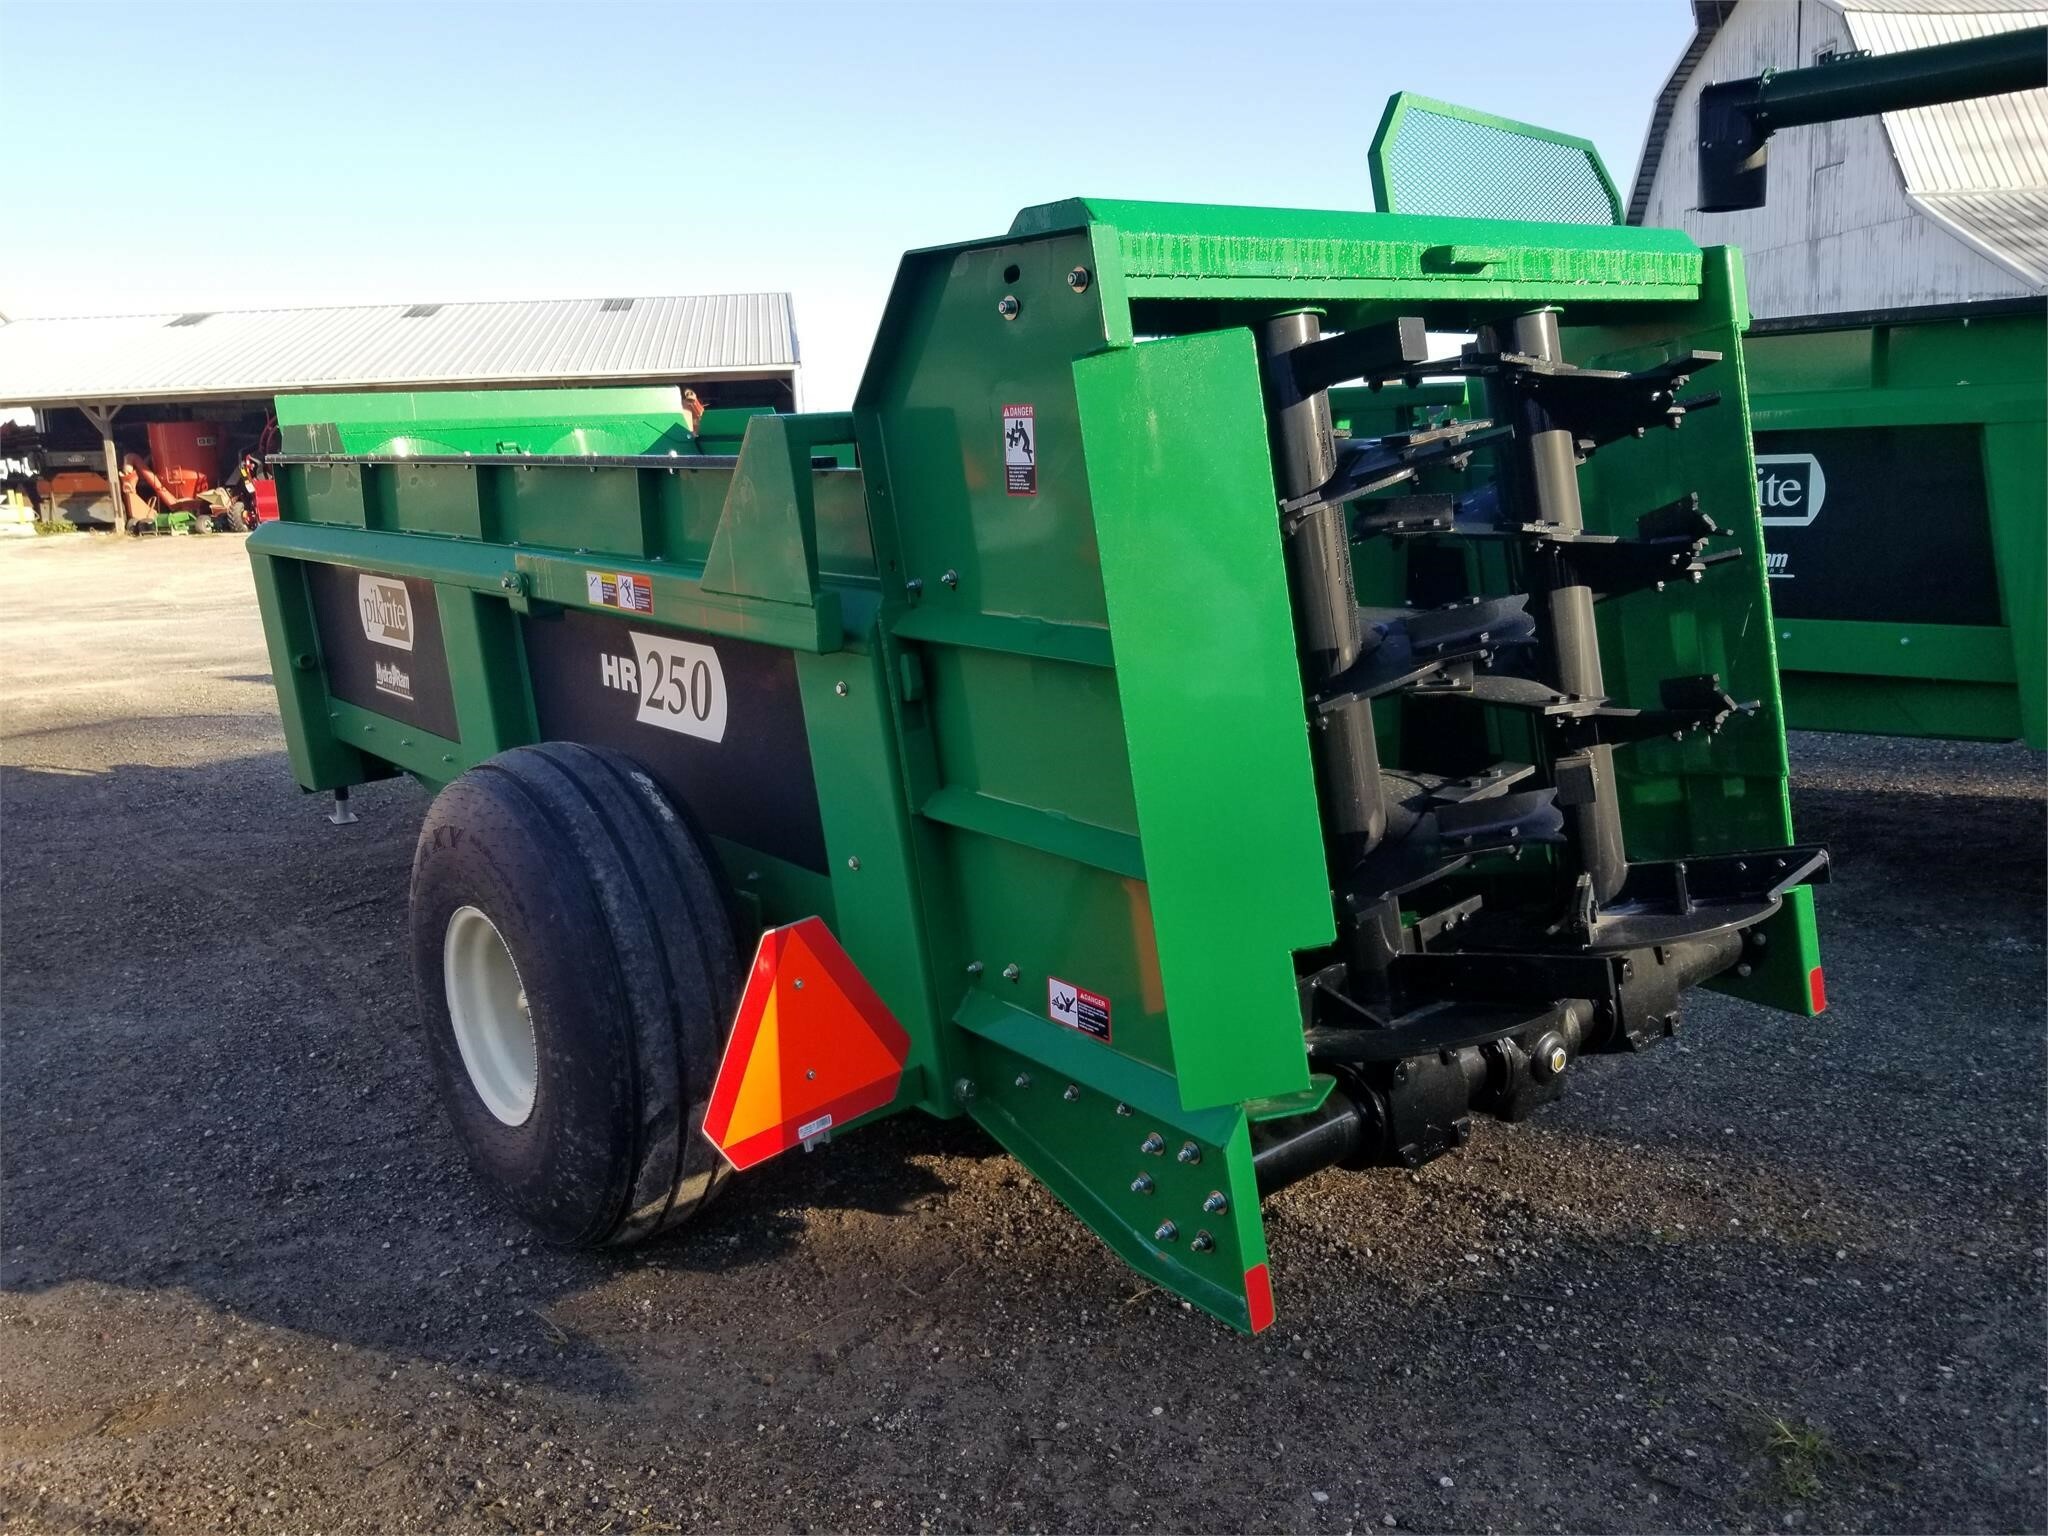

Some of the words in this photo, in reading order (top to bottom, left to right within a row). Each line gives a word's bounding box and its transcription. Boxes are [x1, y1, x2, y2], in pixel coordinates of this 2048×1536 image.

[1009, 406, 1034, 417] DANGER
[363, 588, 407, 632] pikrite
[601, 653, 638, 694] HR
[645, 650, 712, 722] 250
